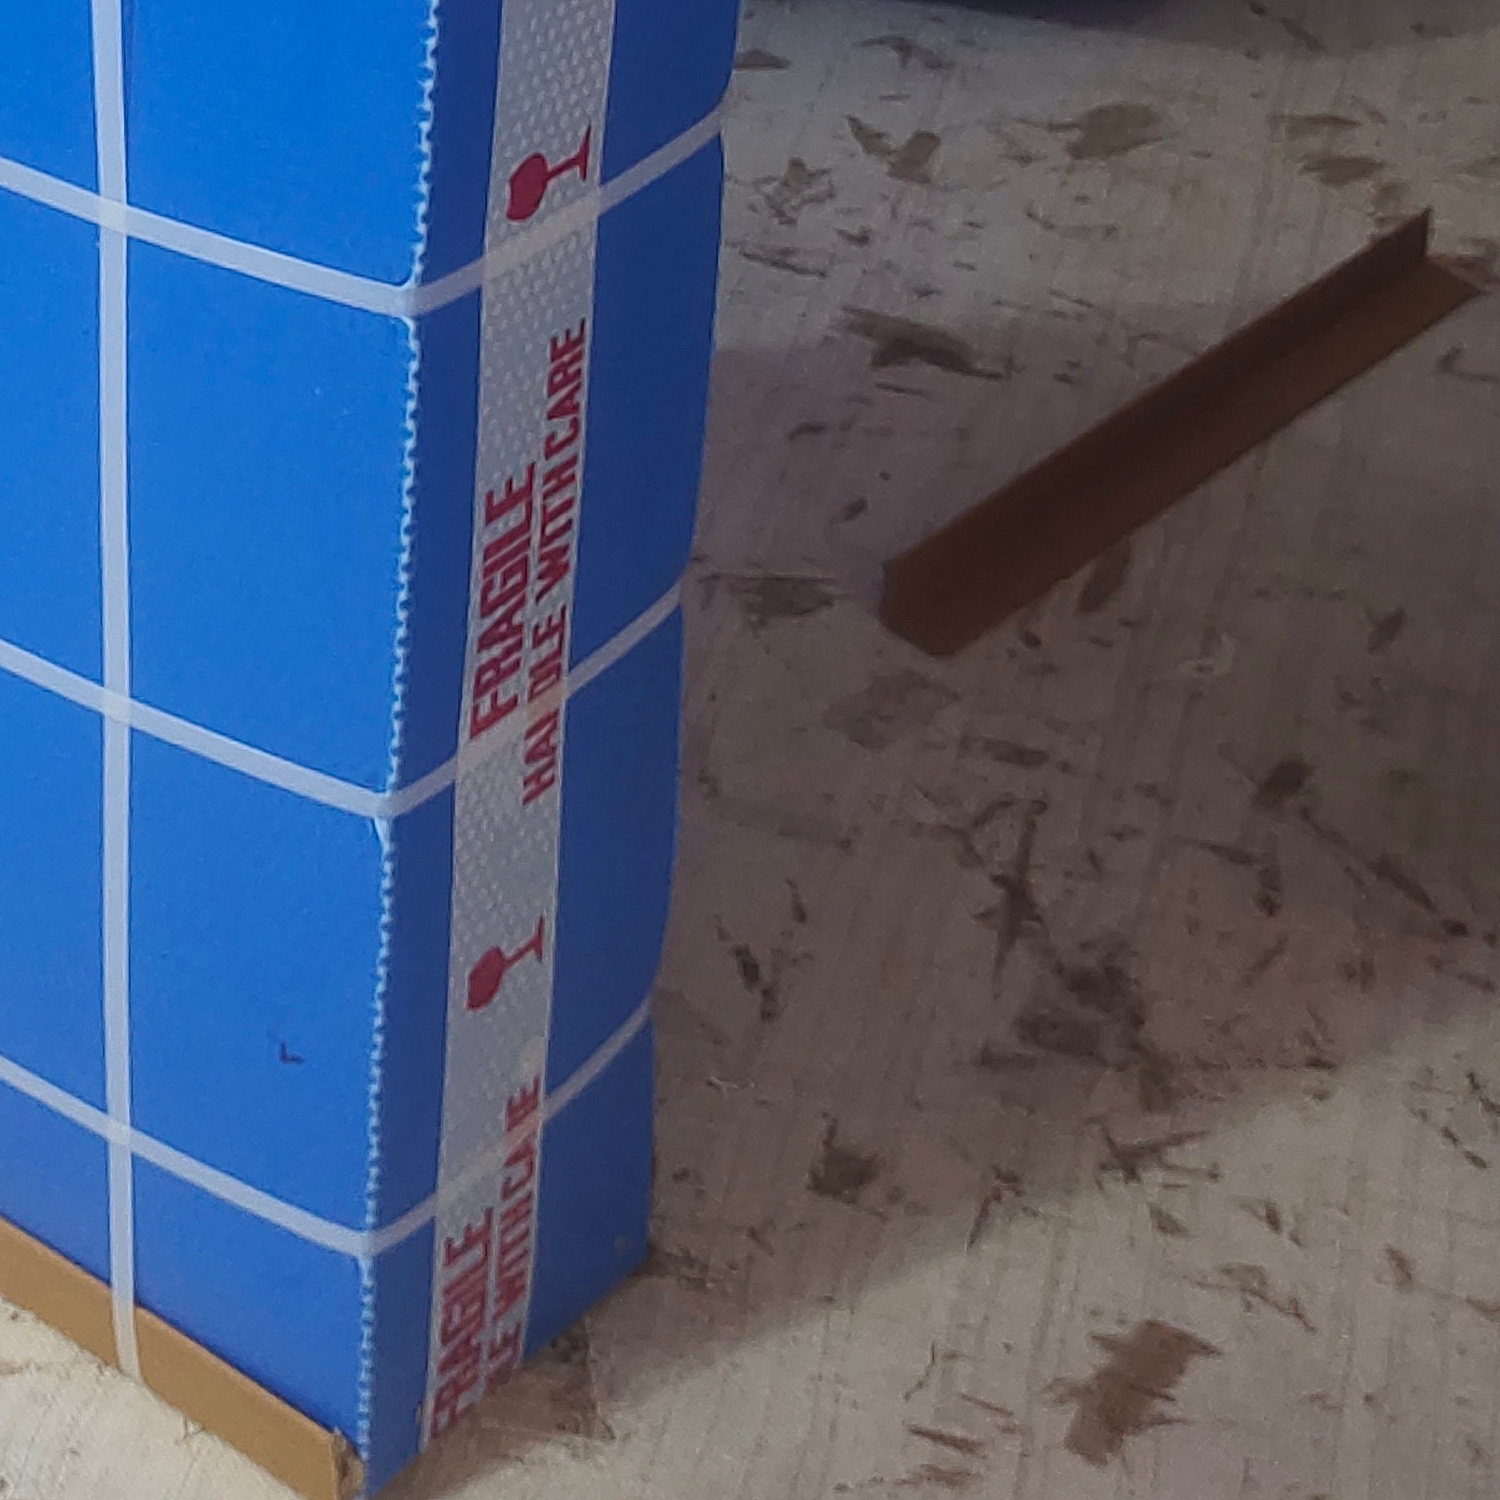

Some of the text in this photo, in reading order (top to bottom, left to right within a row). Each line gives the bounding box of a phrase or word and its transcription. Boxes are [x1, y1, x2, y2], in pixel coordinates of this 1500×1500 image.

[545, 315, 587, 461] CARE
[470, 460, 536, 741] FRAGILE
[536, 453, 578, 605] WITH
[502, 1072, 541, 1201] CAE
[493, 1190, 534, 1322] WITH
